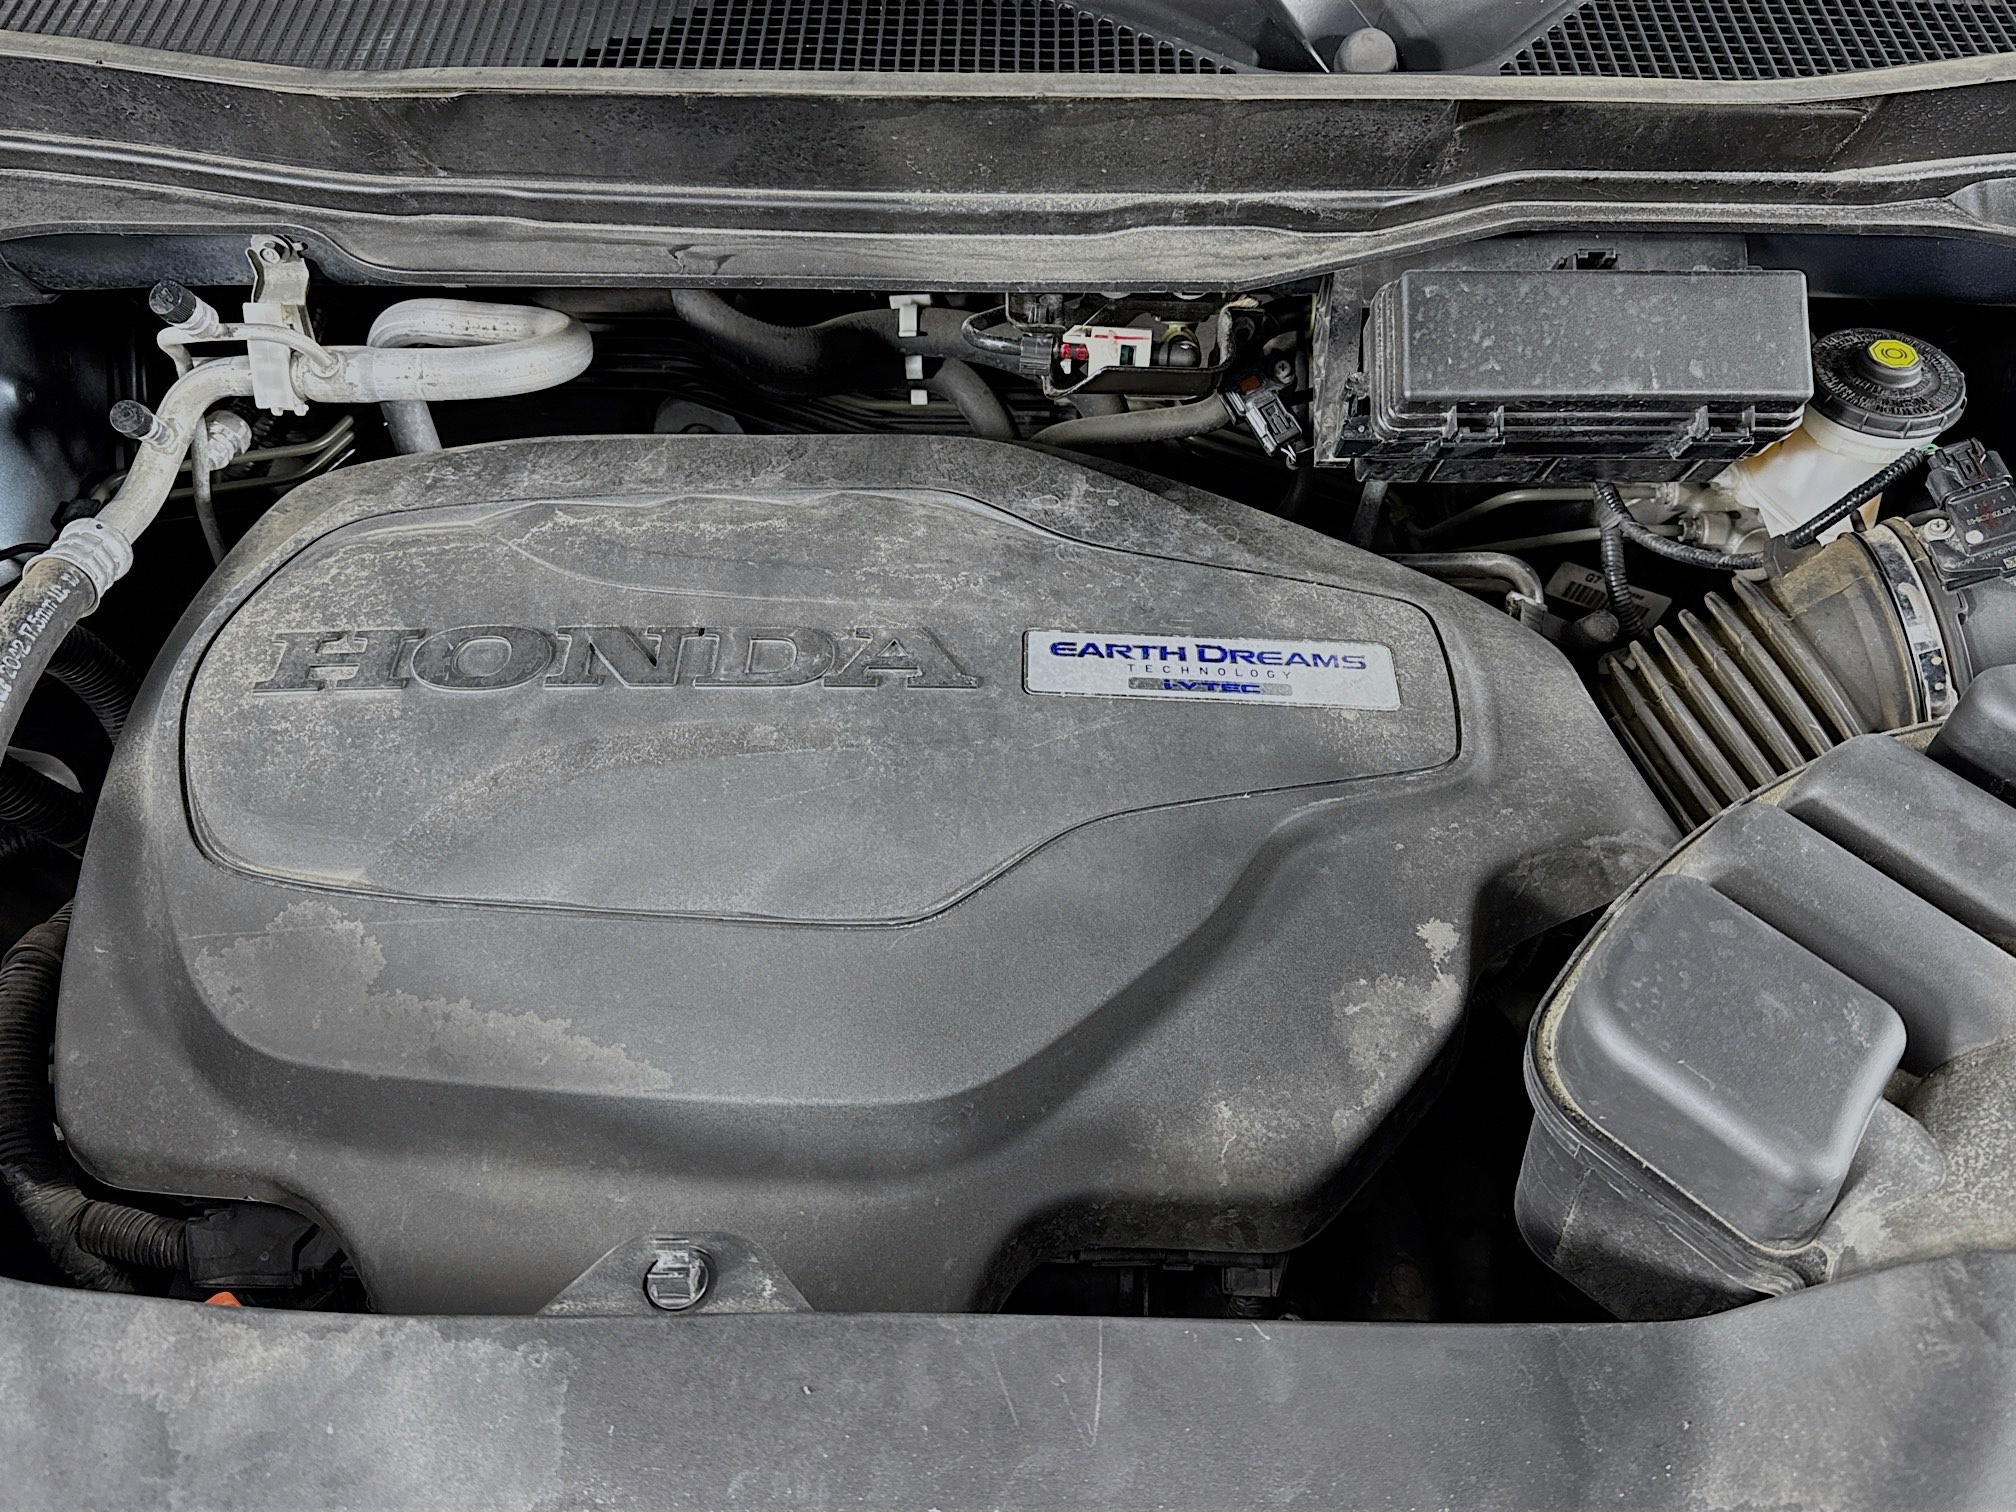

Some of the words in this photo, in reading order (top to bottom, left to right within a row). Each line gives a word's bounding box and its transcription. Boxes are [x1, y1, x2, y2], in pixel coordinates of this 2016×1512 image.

[1966, 504, 2016, 526] HITACHI
[253, 622, 980, 693] HONDA
[1049, 640, 1188, 663] EARTH
[1195, 643, 1367, 670] DREAMS
[1126, 663, 1293, 681] TECHNOLOGY
[1162, 678, 1262, 694] i-VTEC
